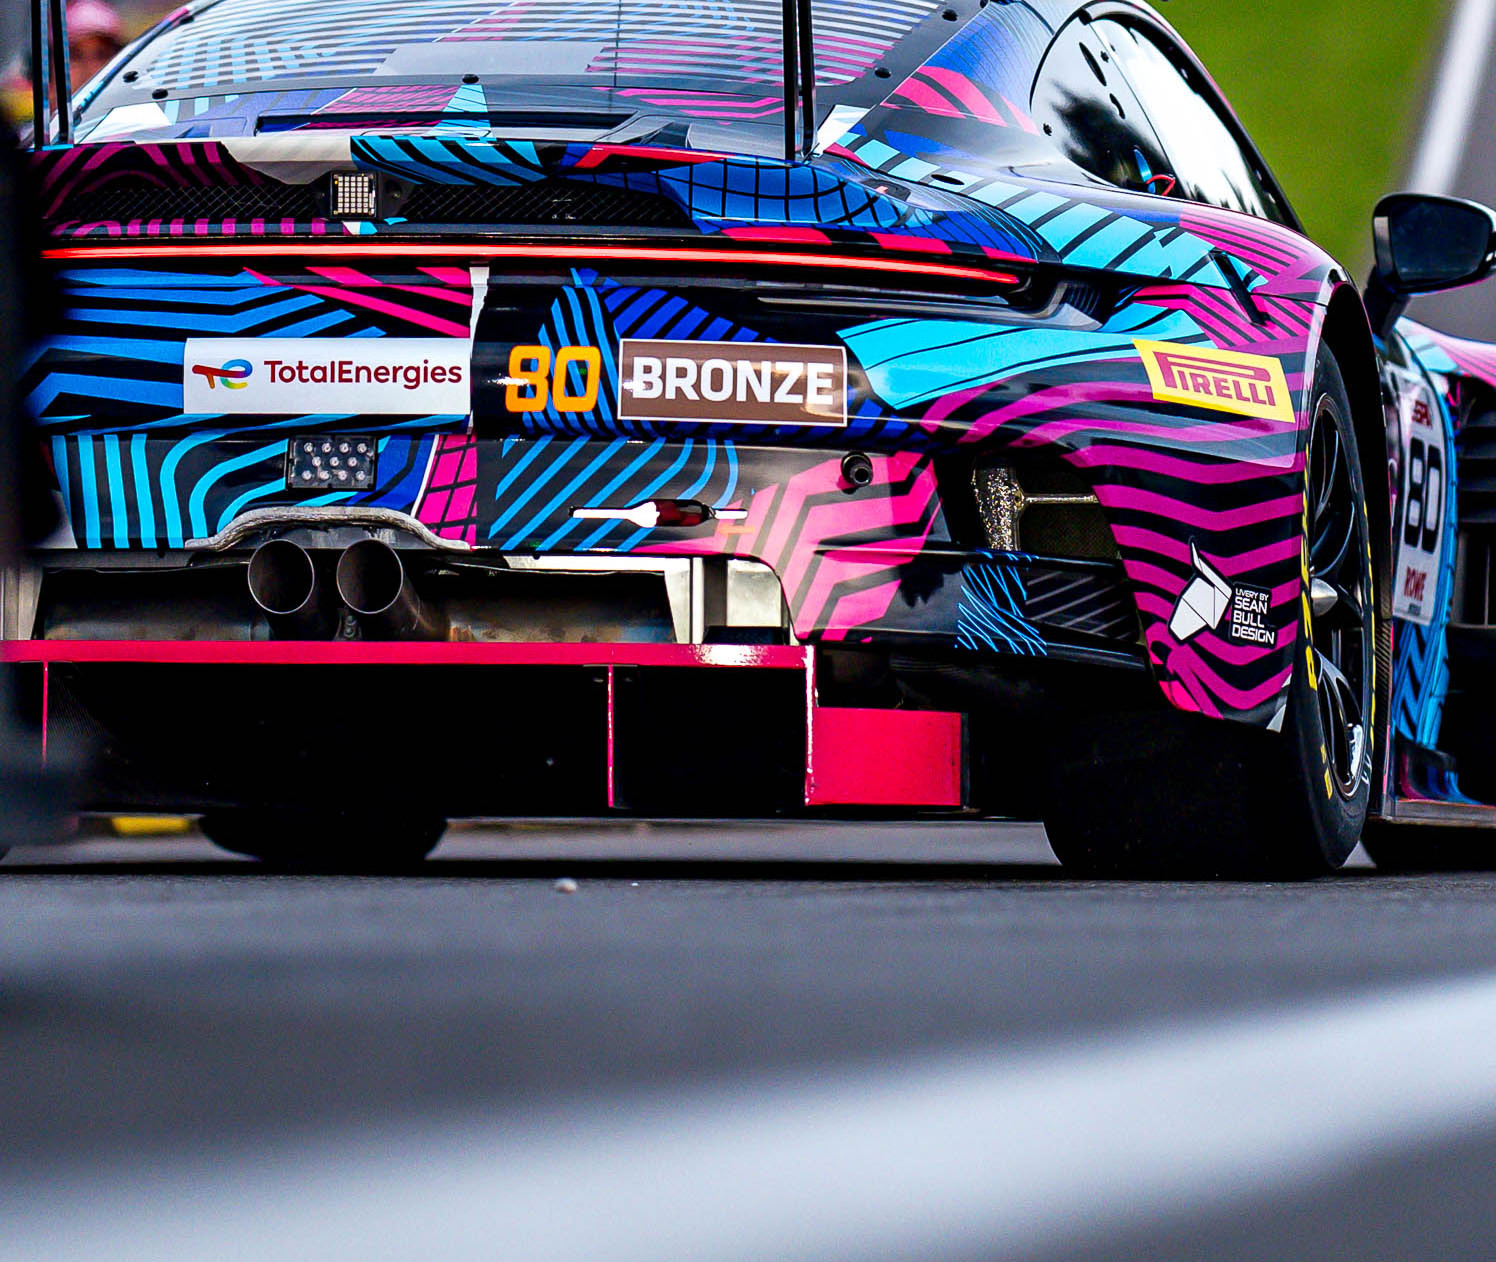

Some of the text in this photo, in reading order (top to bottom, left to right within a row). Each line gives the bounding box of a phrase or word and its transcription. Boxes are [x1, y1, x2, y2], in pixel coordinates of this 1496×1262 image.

[264, 359, 462, 389] TotalEnergies
[505, 345, 601, 413] 80
[632, 356, 834, 405] BRONZE
[1152, 350, 1276, 407] PIRELLI
[1405, 436, 1442, 555] 80
[1234, 596, 1268, 614] SEAN
[1235, 587, 1269, 601] LIVERY BY
[1233, 610, 1265, 628] BULL
[1232, 624, 1275, 645] DESIGN
